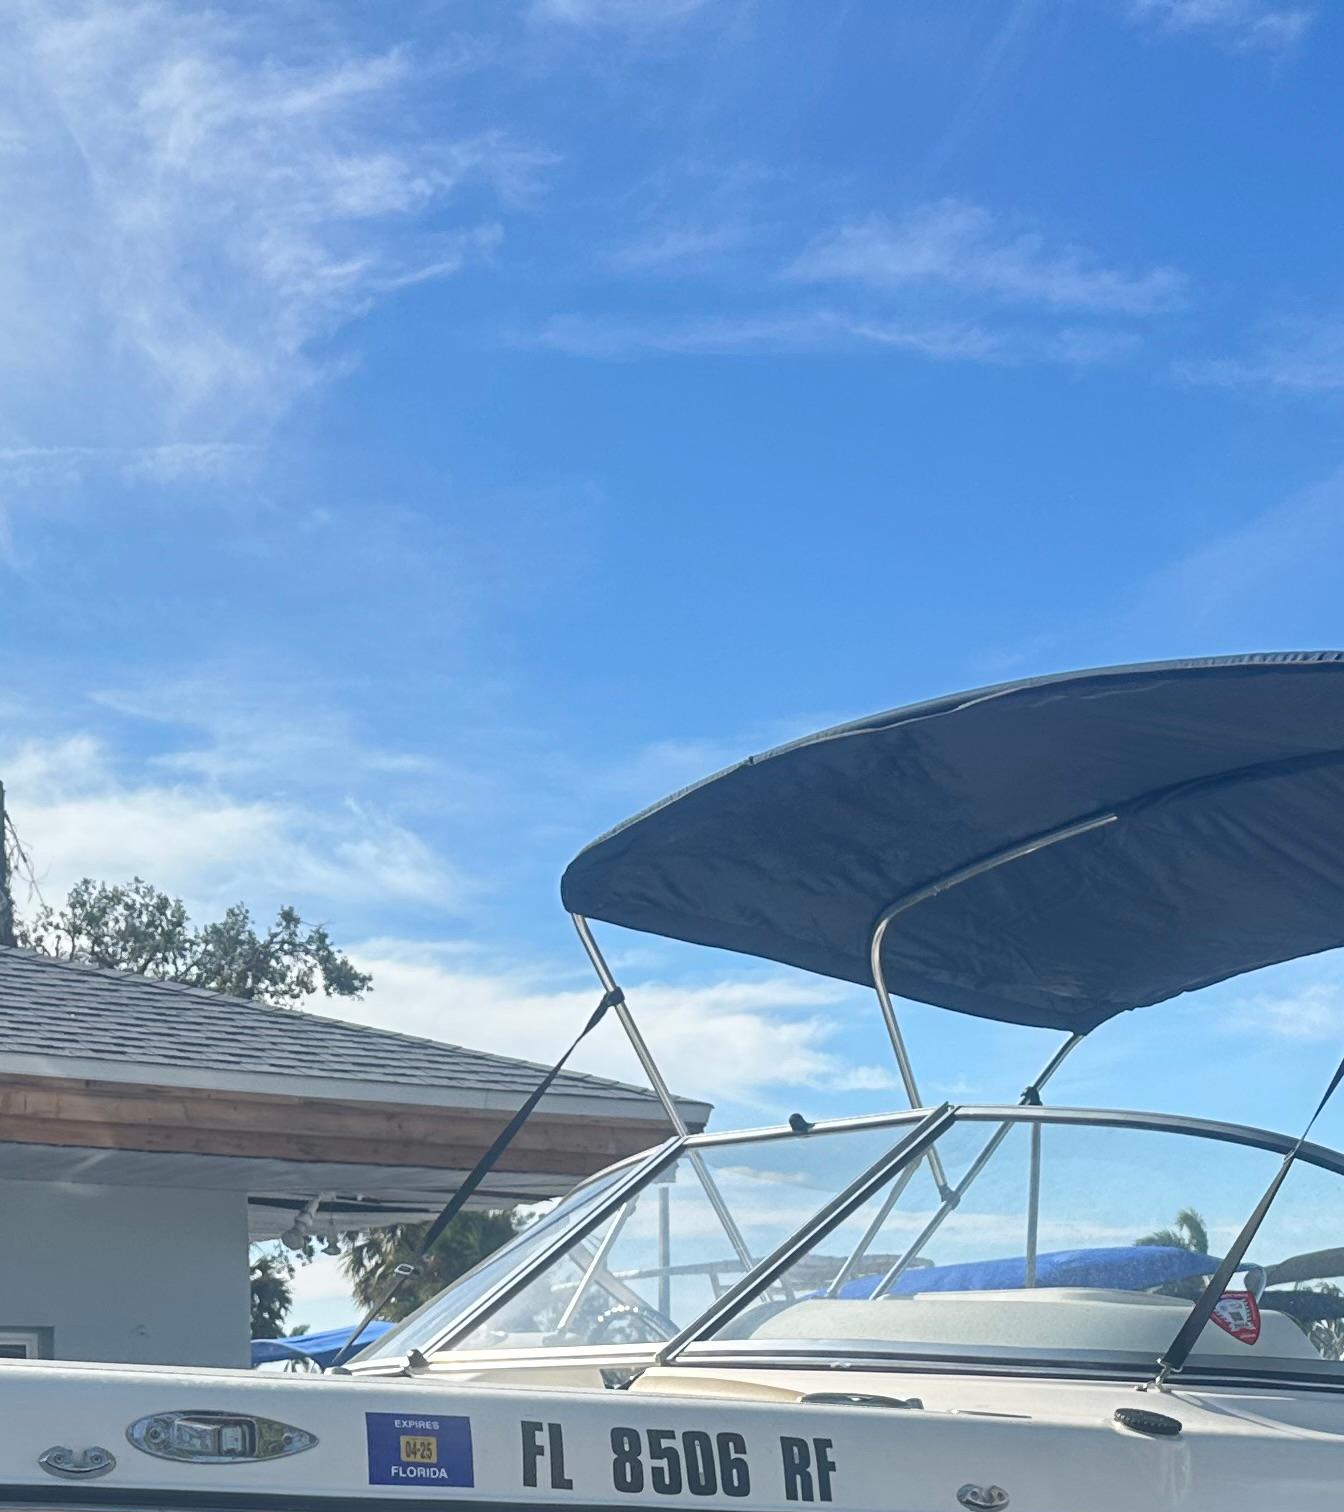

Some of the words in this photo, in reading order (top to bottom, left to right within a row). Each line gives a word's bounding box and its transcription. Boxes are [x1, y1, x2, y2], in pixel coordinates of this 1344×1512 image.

[394, 1419, 440, 1430] EXPIRES
[405, 1440, 433, 1460] 04-25
[520, 1420, 573, 1490] FL
[610, 1426, 750, 1497] 8506
[779, 1435, 837, 1502] RF
[391, 1465, 448, 1479] FLORIDA
